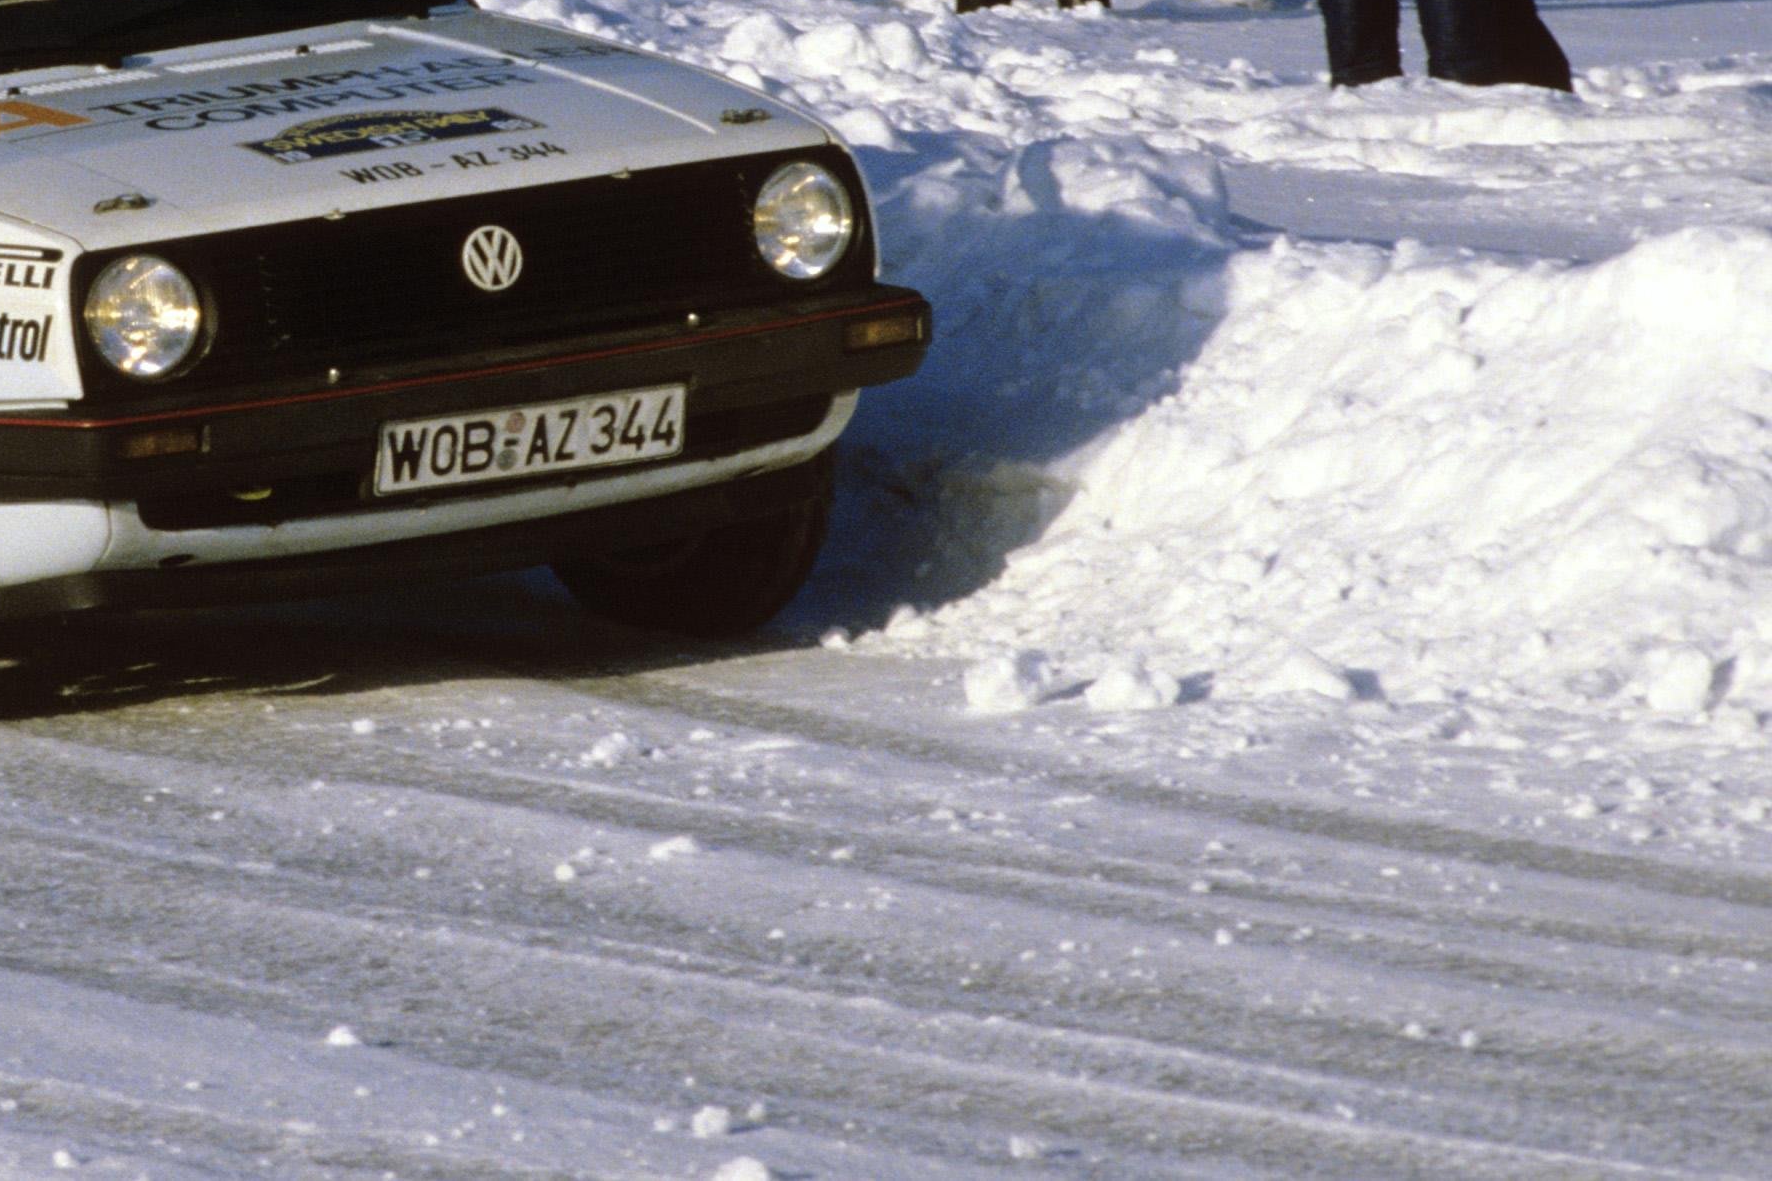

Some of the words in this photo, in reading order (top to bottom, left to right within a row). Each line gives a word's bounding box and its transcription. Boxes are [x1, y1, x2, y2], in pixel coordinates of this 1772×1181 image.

[144, 72, 537, 132] COMPUTER
[337, 161, 426, 185] WOB
[449, 150, 500, 170] AZ
[498, 139, 569, 163] 344
[590, 394, 676, 456] 344
